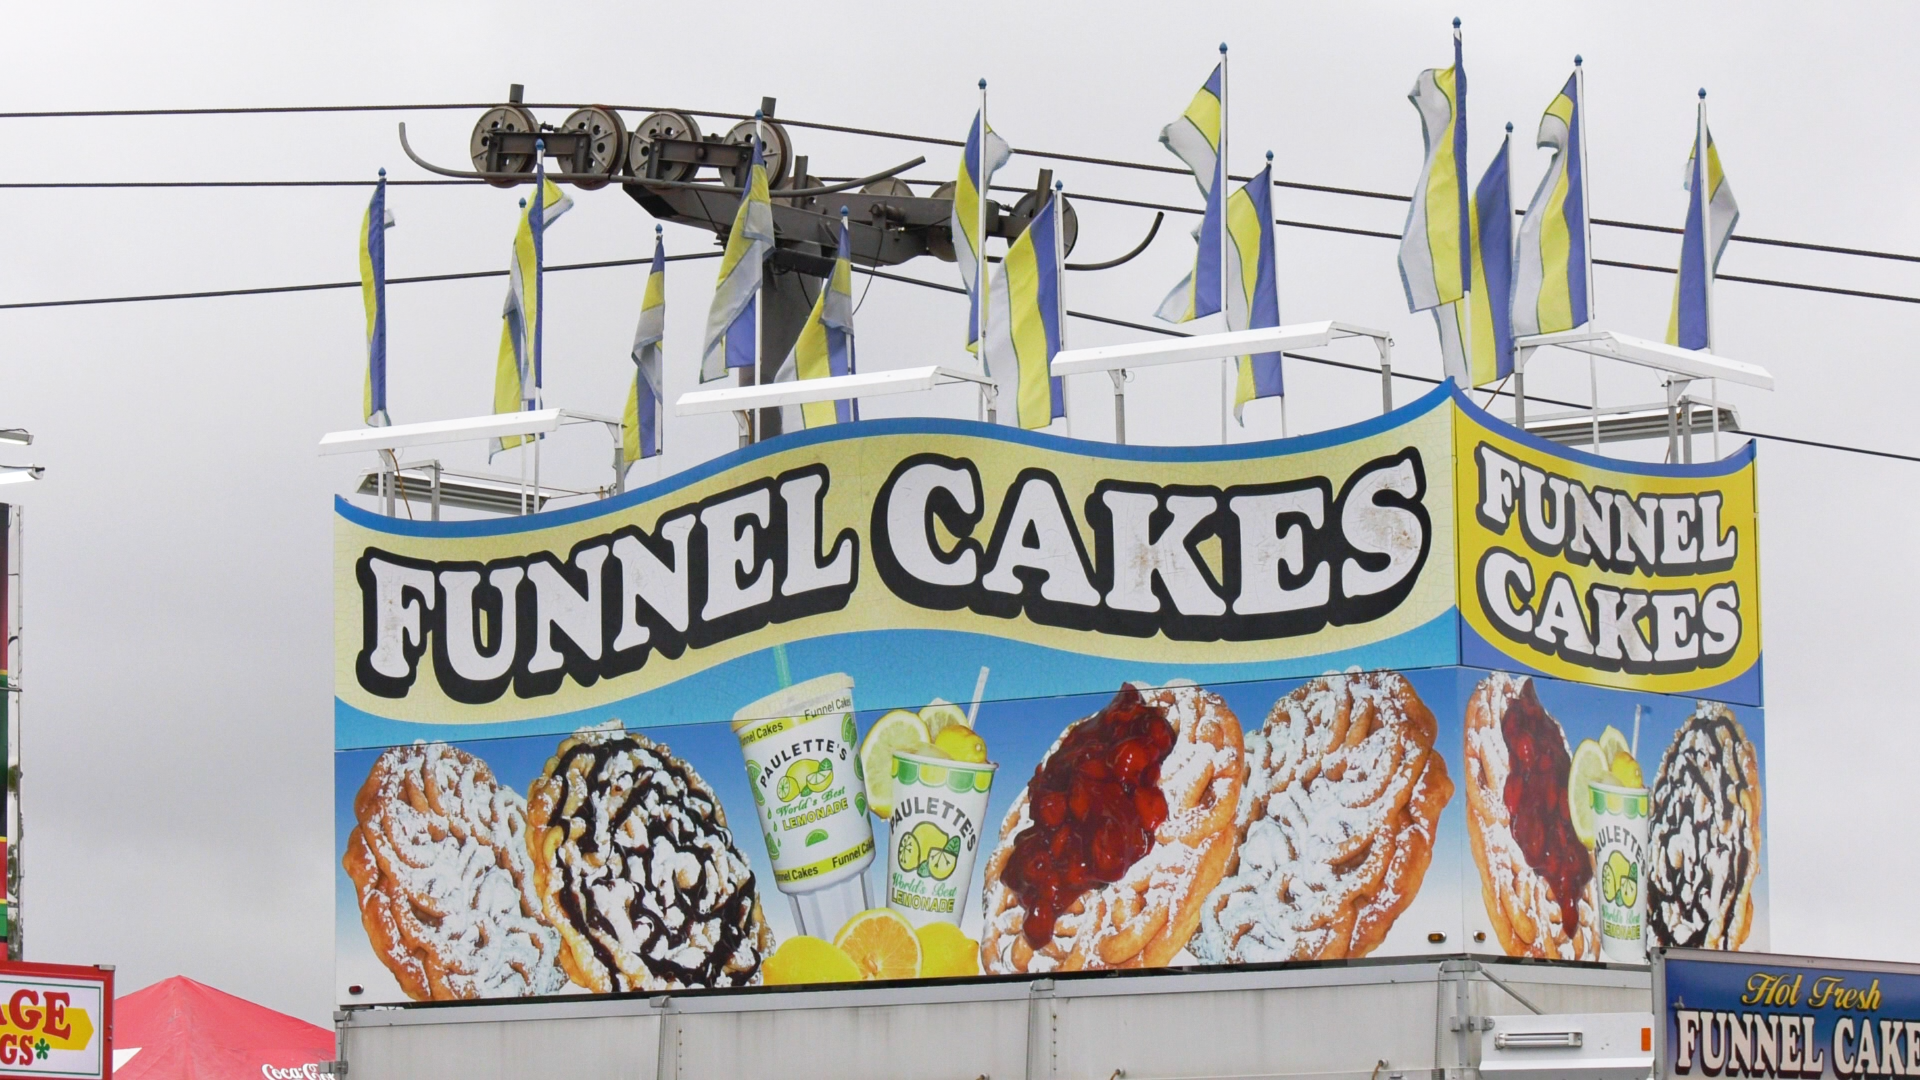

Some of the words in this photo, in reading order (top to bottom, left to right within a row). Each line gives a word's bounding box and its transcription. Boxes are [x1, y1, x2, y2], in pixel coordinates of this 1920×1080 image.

[1474, 441, 1738, 577] FUNNEL
[355, 462, 859, 704] FUNNEL
[871, 446, 1431, 642] CAKES
[1476, 546, 1742, 675] CAKES
[757, 722, 784, 739] Cakes
[804, 701, 835, 720] Funnel
[760, 738, 848, 788] PAULETTE'S
[776, 797, 817, 817] World's
[821, 786, 846, 803] Best
[782, 797, 848, 831] LEMONADE
[890, 797, 976, 852] PAULETTE'S
[792, 866, 819, 880] Cakes
[832, 847, 861, 868] Funnel
[891, 888, 955, 913] LEMONADE
[892, 872, 926, 895] World's
[931, 882, 957, 898] Best
[1742, 971, 1804, 1007] Hot
[1808, 976, 1882, 1011] Fresh
[1676, 1009, 1824, 1078] FUNNEL
[1833, 1015, 1920, 1080] CAKE
